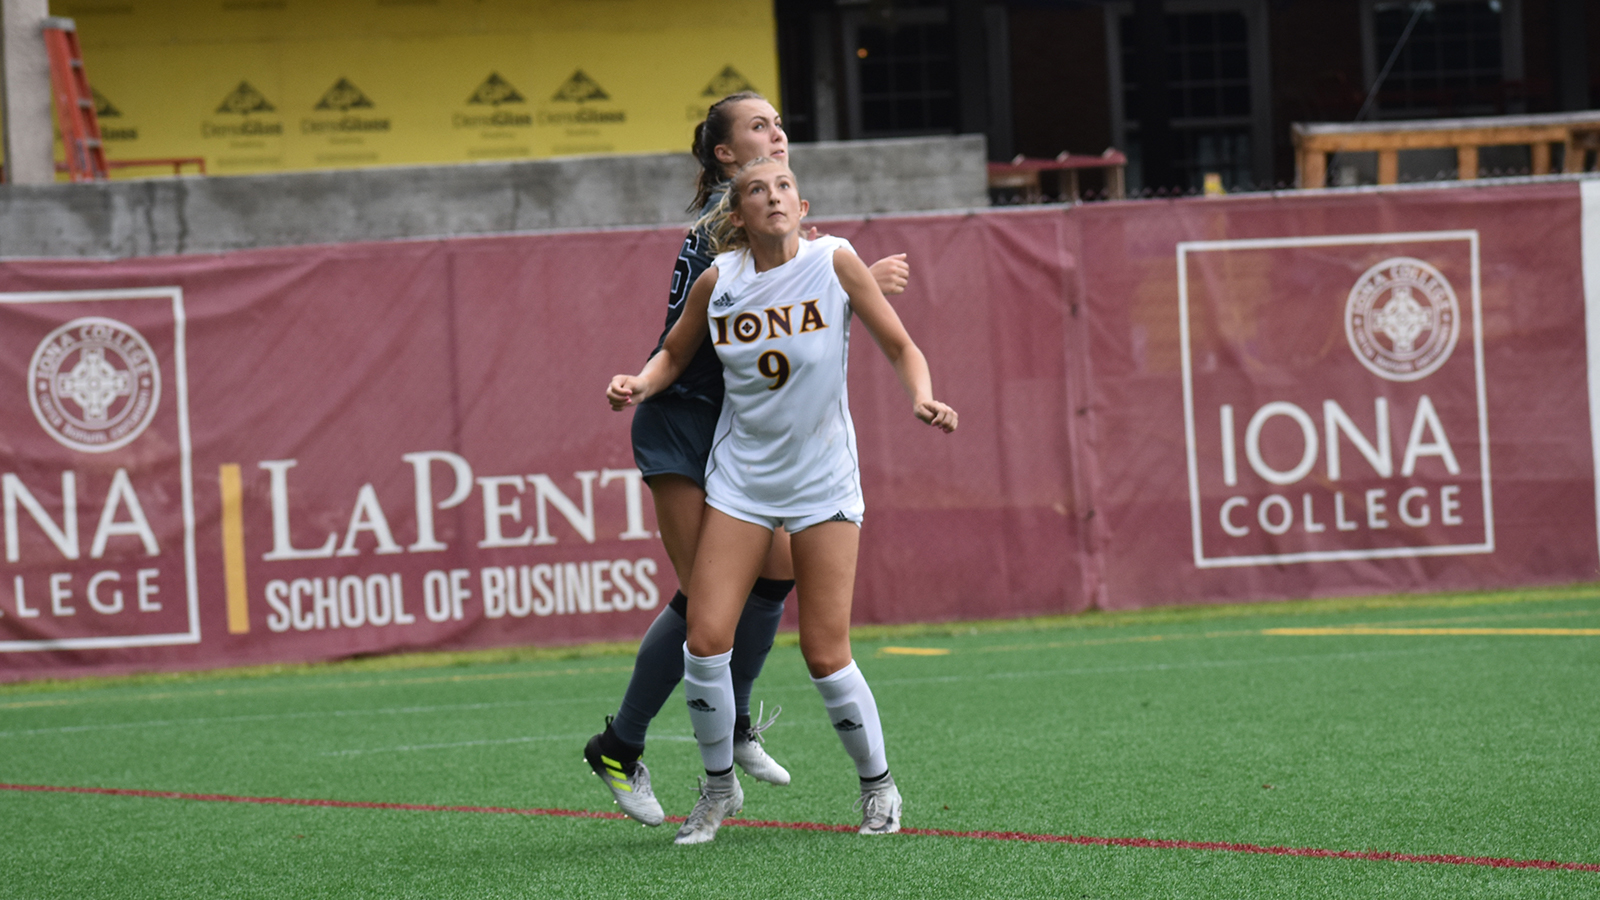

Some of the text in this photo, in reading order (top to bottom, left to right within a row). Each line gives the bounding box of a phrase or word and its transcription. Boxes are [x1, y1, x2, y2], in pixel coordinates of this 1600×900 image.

[710, 298, 829, 346] IONA
[37, 325, 151, 378] IONA COLLEGE
[757, 349, 791, 391] 9
[1219, 394, 1461, 487] IONA
[1219, 485, 1463, 537] COLLEGE
[0, 567, 163, 619] LEGE
[264, 557, 660, 633] SCHOOL OF BUSINESS
